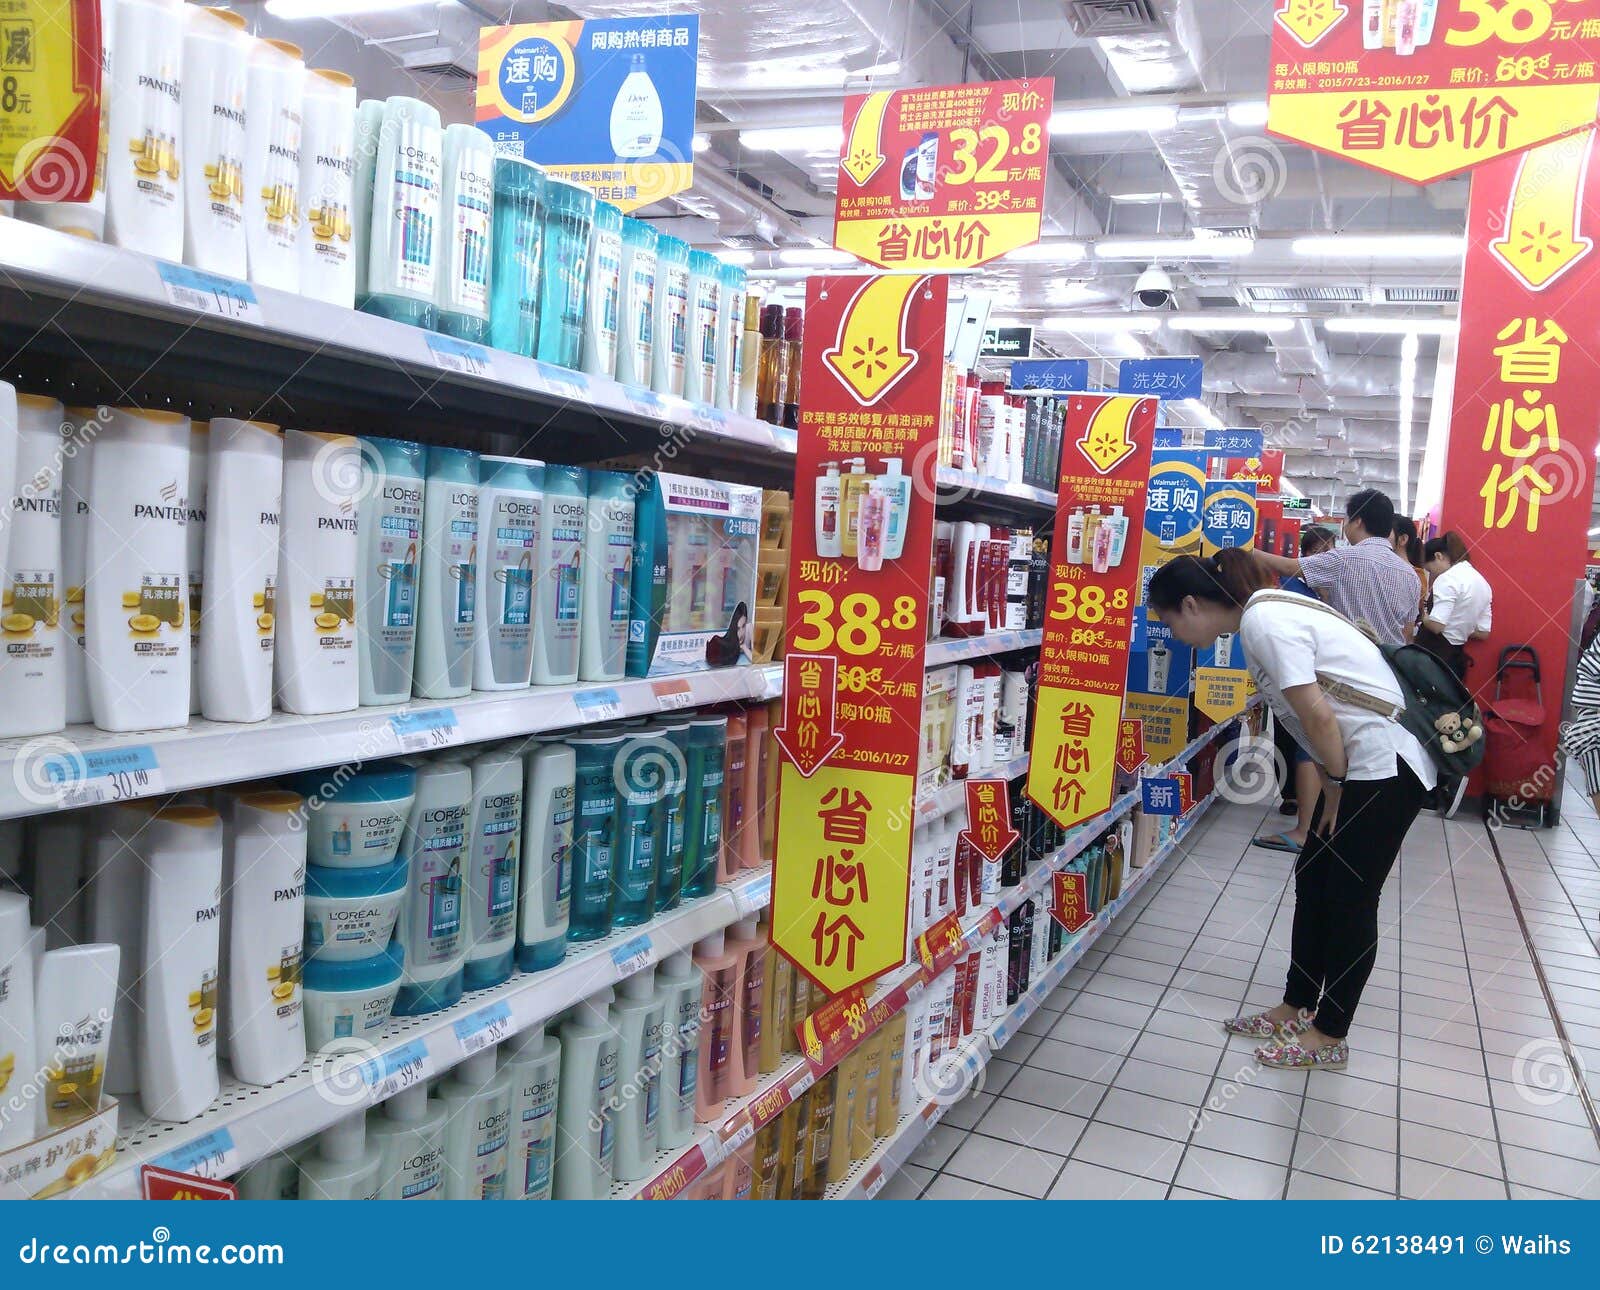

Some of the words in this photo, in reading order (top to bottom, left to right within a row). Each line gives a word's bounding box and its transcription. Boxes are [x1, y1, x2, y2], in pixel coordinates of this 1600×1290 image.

[591, 28, 689, 50] 网购热销商品
[514, 46, 540, 55] Walmart
[505, 54, 558, 84] 速购
[1275, 60, 1359, 77] 每人限购10瓶
[1450, 67, 1490, 84] 原价:
[1553, 62, 1594, 79] 元/瓶
[1274, 78, 1313, 91] 有效期:
[1003, 91, 1044, 112] 现价:
[1336, 94, 1519, 150] 省心价
[945, 123, 1041, 185] 32.8
[1008, 167, 1041, 182] 元/瓶
[840, 196, 892, 209] 每人限购10瓶
[1011, 198, 1037, 209] 元/瓶
[877, 219, 990, 262] 省心价
[1133, 372, 1187, 389] 洗发水
[802, 411, 935, 428] 欧莱雅多效修复/精油润养
[1480, 316, 1568, 533] 省心价
[816, 425, 919, 441] /透明质酸/角质顺滑
[1214, 436, 1253, 448] 洗发水
[827, 441, 905, 455] 洗发露700毫升
[1146, 488, 1198, 512] 速购
[1208, 509, 1251, 530] 速购
[800, 560, 848, 584] 现价:
[1055, 564, 1087, 580] 现价:
[1050, 582, 1128, 624] 38.8
[793, 589, 917, 656] 38.8
[1103, 615, 1126, 627] 元/瓶
[879, 642, 916, 659] 元/瓶
[1046, 632, 1069, 644] 原价:
[1103, 639, 1127, 650] 元/瓶
[1044, 647, 1111, 666] 每人限购10瓶
[1043, 663, 1074, 675] 有效期:
[881, 680, 917, 698] 元/瓶
[798, 660, 822, 750] 省心价
[1122, 722, 1136, 761] 省心价
[1051, 702, 1095, 814] 省心价
[1150, 786, 1174, 808] 新
[977, 784, 1000, 843] 省心价
[811, 787, 872, 972] 省心价
[1062, 876, 1078, 920] 省心价
[755, 1089, 785, 1121] 省心价
